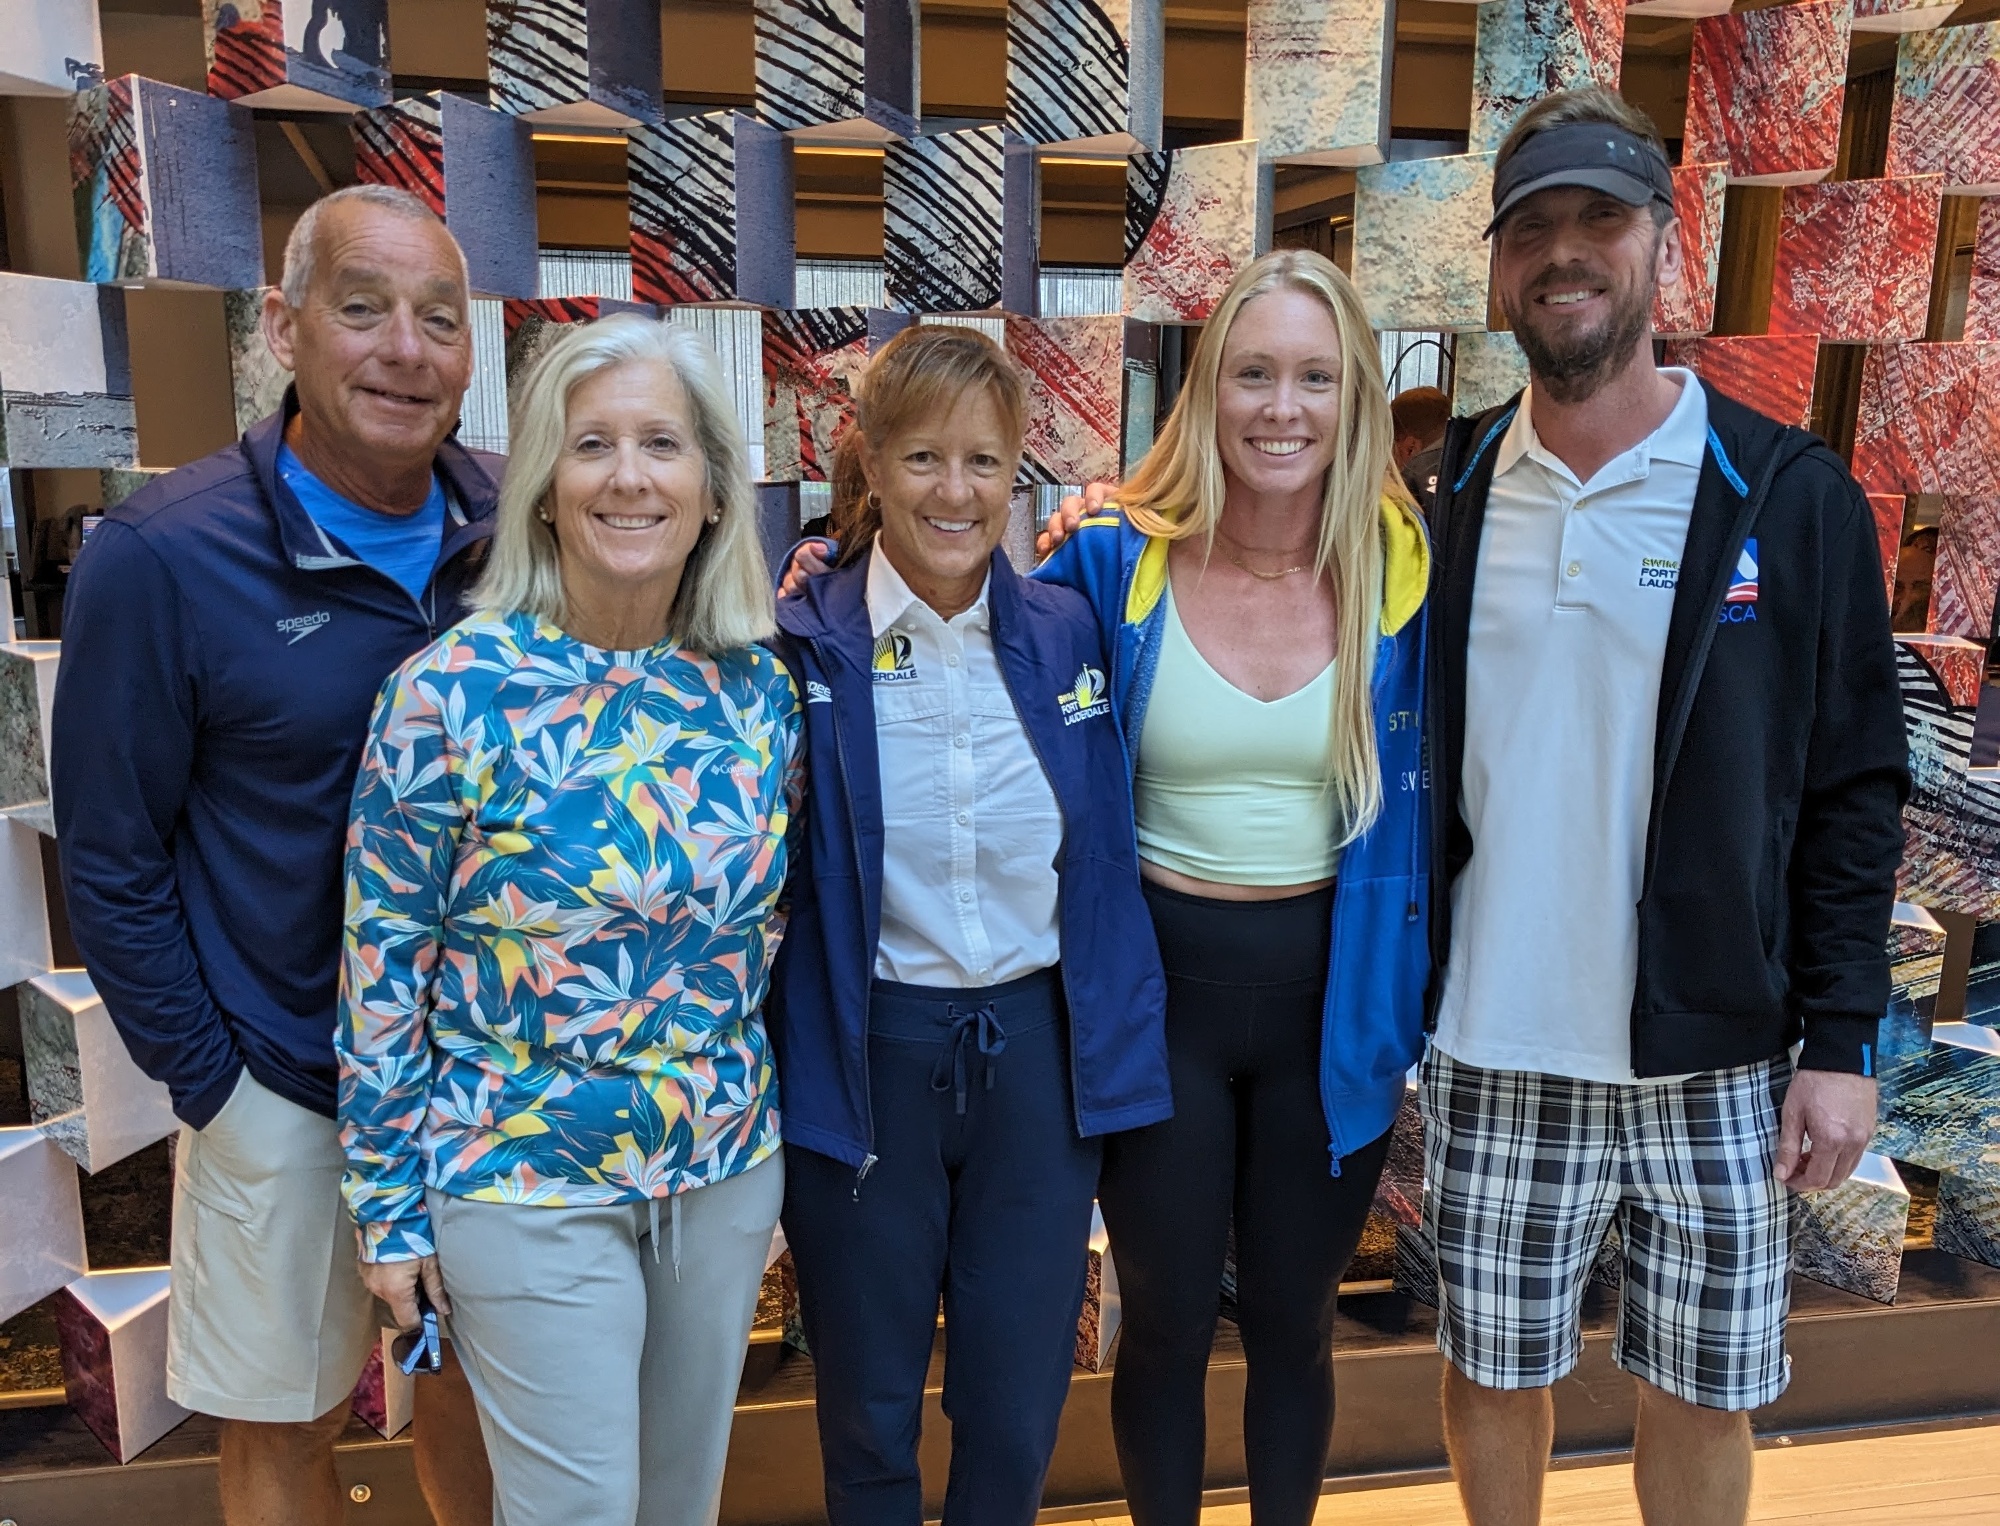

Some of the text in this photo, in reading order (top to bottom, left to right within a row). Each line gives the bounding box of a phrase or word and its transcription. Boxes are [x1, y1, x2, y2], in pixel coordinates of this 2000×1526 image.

[1642, 557, 1679, 569] SWIM
[1641, 568, 1677, 579] FORT
[1639, 577, 1677, 590] LAUD
[276, 610, 331, 633] speedo
[871, 669, 918, 681] ERDALE
[1057, 691, 1076, 705] SWIM
[1061, 700, 1079, 715] FORT
[1064, 703, 1111, 727] LAUDERDALE
